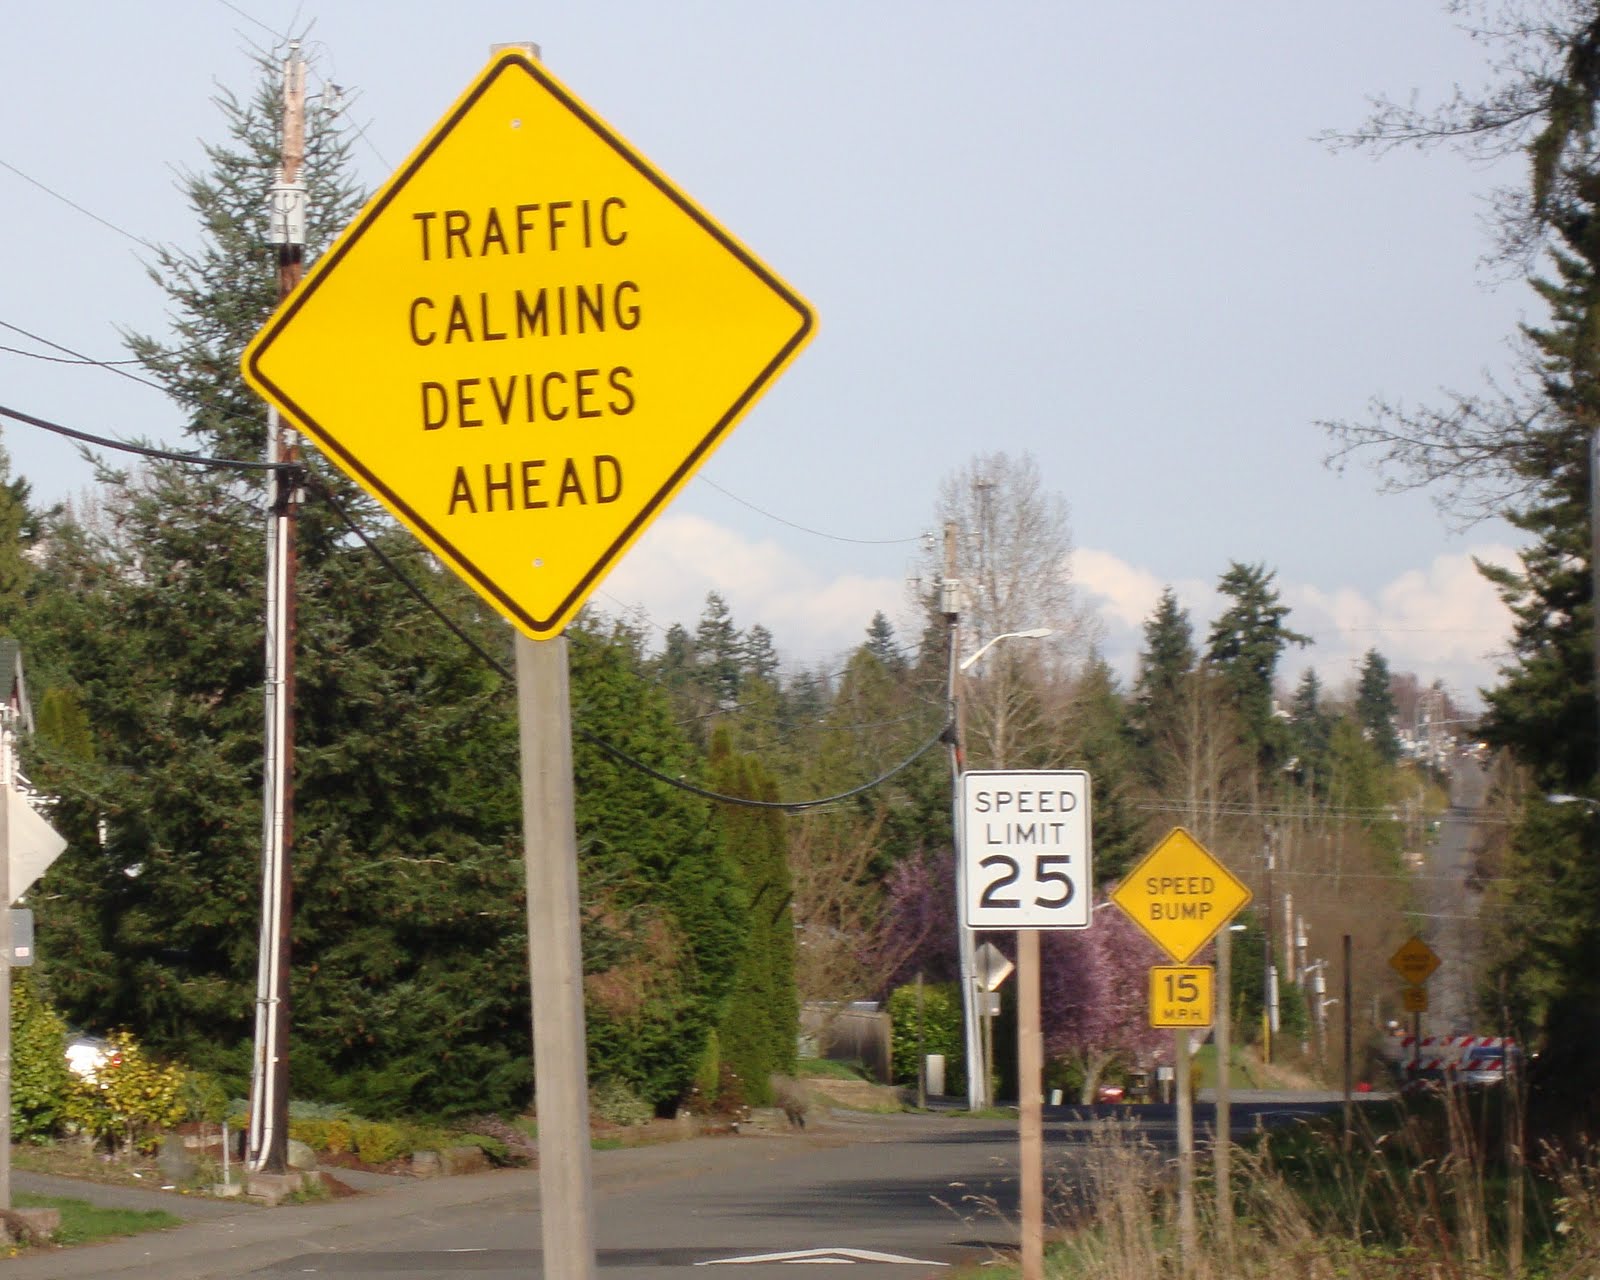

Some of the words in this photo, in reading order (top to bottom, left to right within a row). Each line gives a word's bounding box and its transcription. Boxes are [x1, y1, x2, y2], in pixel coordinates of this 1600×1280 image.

[413, 197, 628, 261] TRAFFIC
[409, 280, 641, 346] CALMING
[421, 366, 635, 431] DEVICES
[447, 454, 623, 515] AHEAD
[975, 791, 1077, 813] SPEED
[987, 823, 1065, 844] LIMIT
[978, 854, 1075, 909] 25
[1146, 876, 1215, 895] SPEED
[1151, 902, 1213, 920] BUMP
[1164, 974, 1199, 1002] 15
